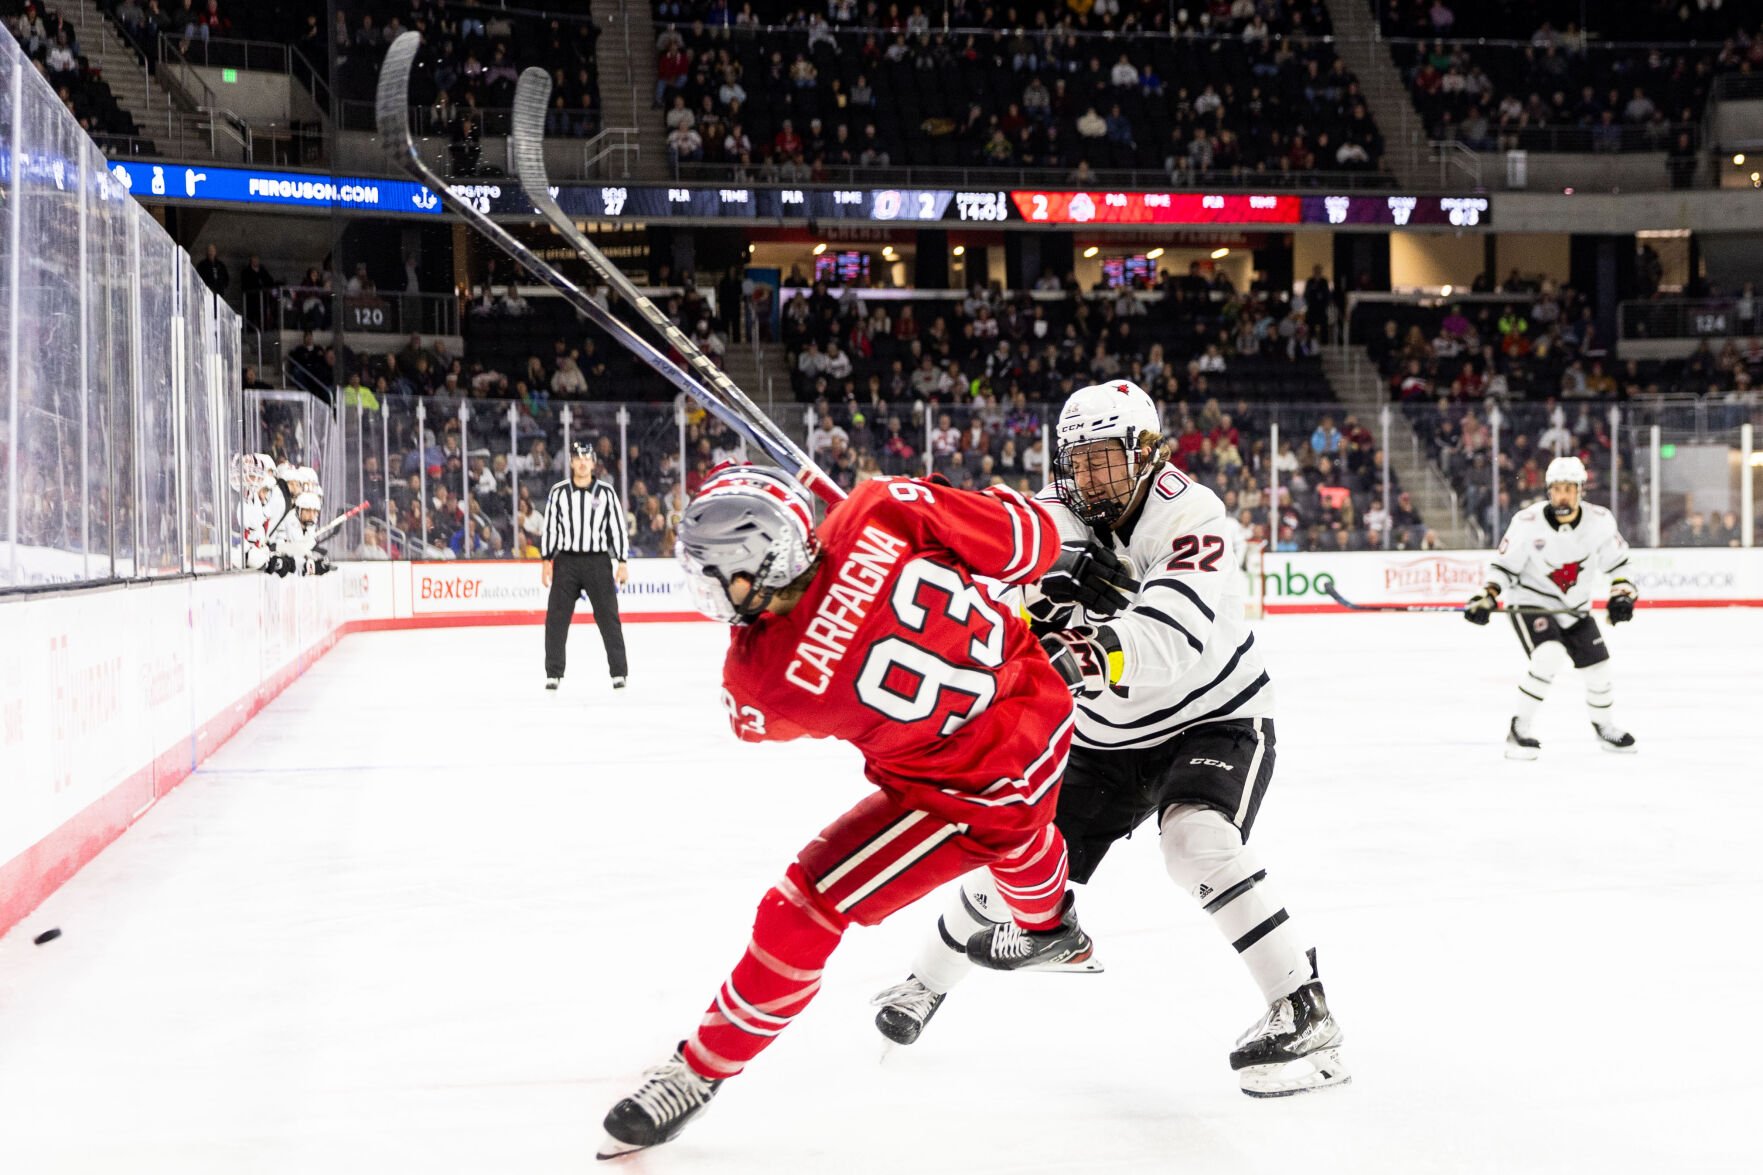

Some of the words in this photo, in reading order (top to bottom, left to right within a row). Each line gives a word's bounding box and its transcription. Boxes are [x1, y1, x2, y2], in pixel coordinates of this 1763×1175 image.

[249, 178, 379, 203] FERGUSON.COM
[719, 190, 748, 203] TIME
[833, 191, 862, 204] TIME
[604, 200, 625, 216] 27
[918, 193, 935, 219] 2
[1032, 194, 1048, 220] 2
[354, 307, 383, 326] 120
[1062, 422, 1085, 433] CCM
[1166, 534, 1225, 572] 22
[1383, 568, 1432, 591] Pizza
[785, 525, 908, 696] CARFAGNA
[854, 556, 1006, 739] 93
[1189, 758, 1234, 771] CCM
